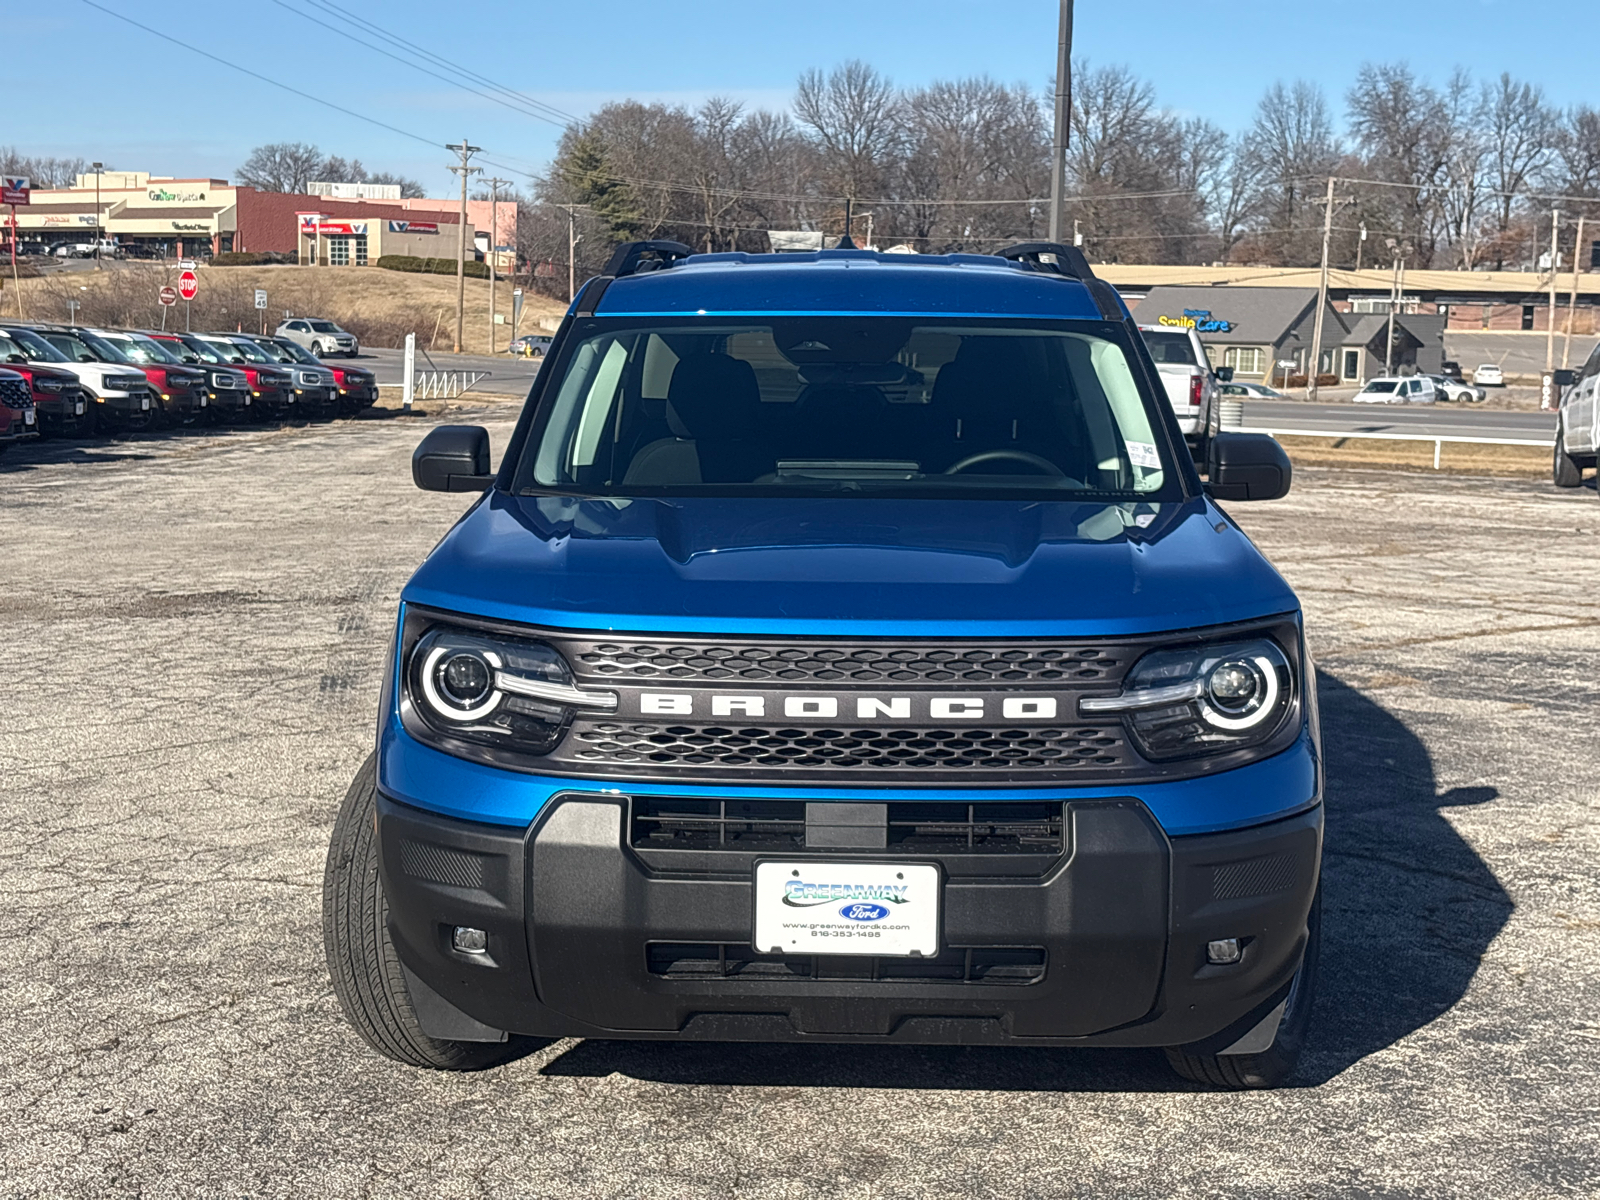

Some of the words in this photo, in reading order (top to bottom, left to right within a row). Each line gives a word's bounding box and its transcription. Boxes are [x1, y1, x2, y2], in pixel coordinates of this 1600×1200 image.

[180, 279, 197, 291] STOP
[256, 300, 267, 308] 45
[1159, 315, 1196, 329] Smile
[1196, 316, 1229, 331] Care
[640, 693, 1057, 719] BRONCO
[785, 880, 908, 900] GREENWAY
[782, 923, 910, 931] www.greenwayfordkc.com
